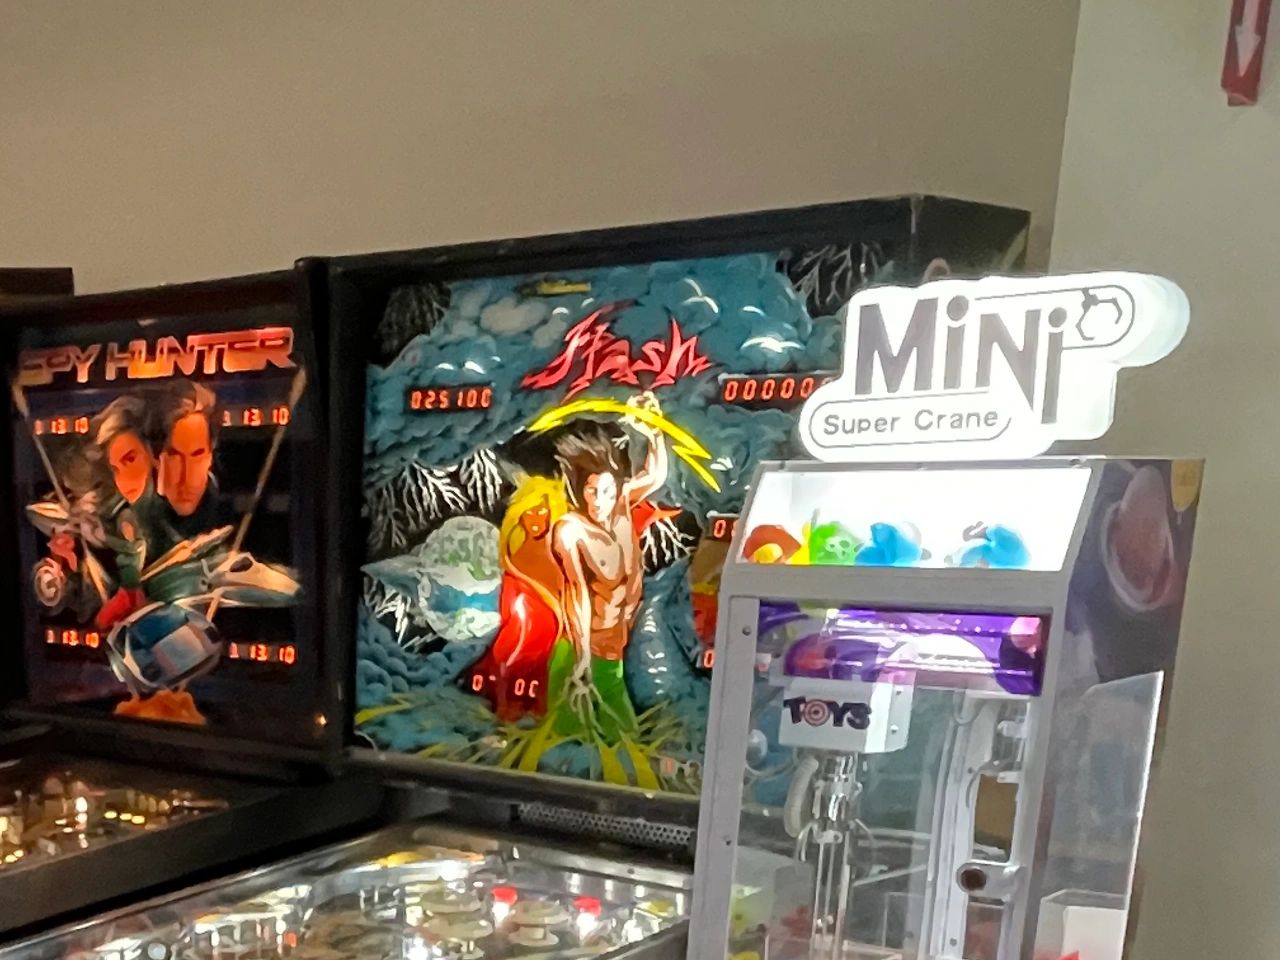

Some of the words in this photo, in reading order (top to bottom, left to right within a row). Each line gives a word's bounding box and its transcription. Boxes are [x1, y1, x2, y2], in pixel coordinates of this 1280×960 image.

[18, 344, 102, 387] SPY
[105, 326, 297, 381] HUNTER
[724, 377, 833, 402] 00000
[823, 413, 900, 436] Super
[914, 409, 998, 430] Crane
[783, 696, 872, 730] TOYS
